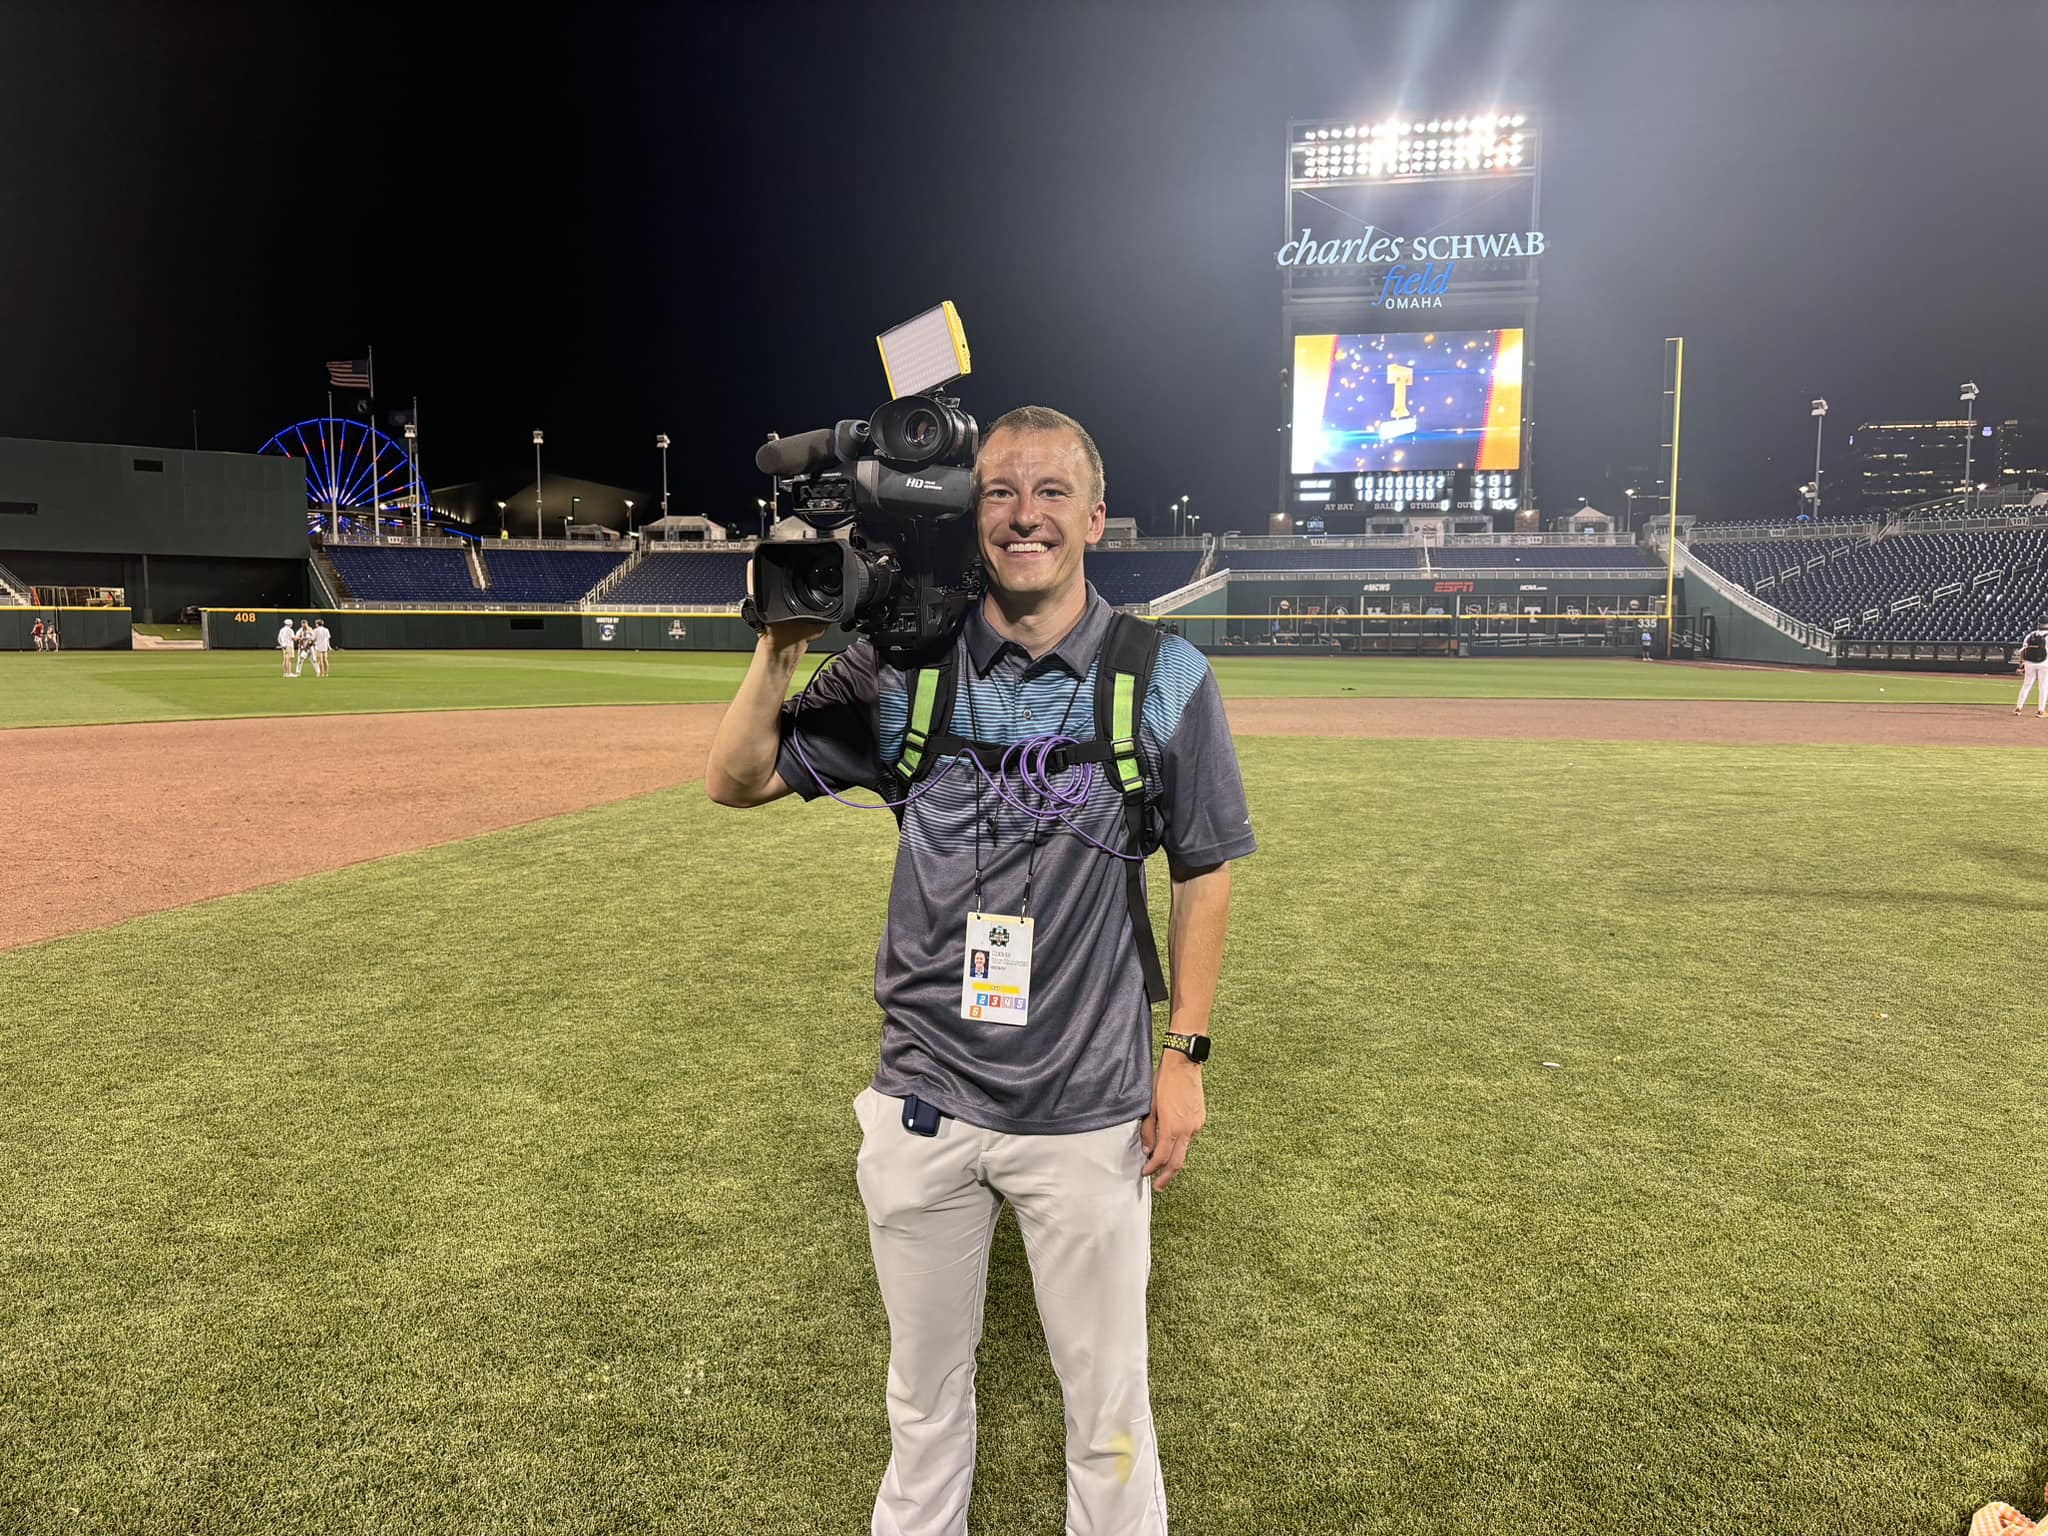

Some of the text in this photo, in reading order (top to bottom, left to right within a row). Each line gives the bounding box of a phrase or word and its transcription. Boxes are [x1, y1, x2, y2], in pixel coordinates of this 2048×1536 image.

[1277, 226, 1545, 266] charles SCHWAB
[1371, 262, 1455, 306] field
[1385, 297, 1443, 309] OMAHA
[905, 478, 924, 488] HD
[1434, 582, 1474, 592] ESPN
[234, 612, 257, 623] 408
[1637, 618, 1657, 628] 335
